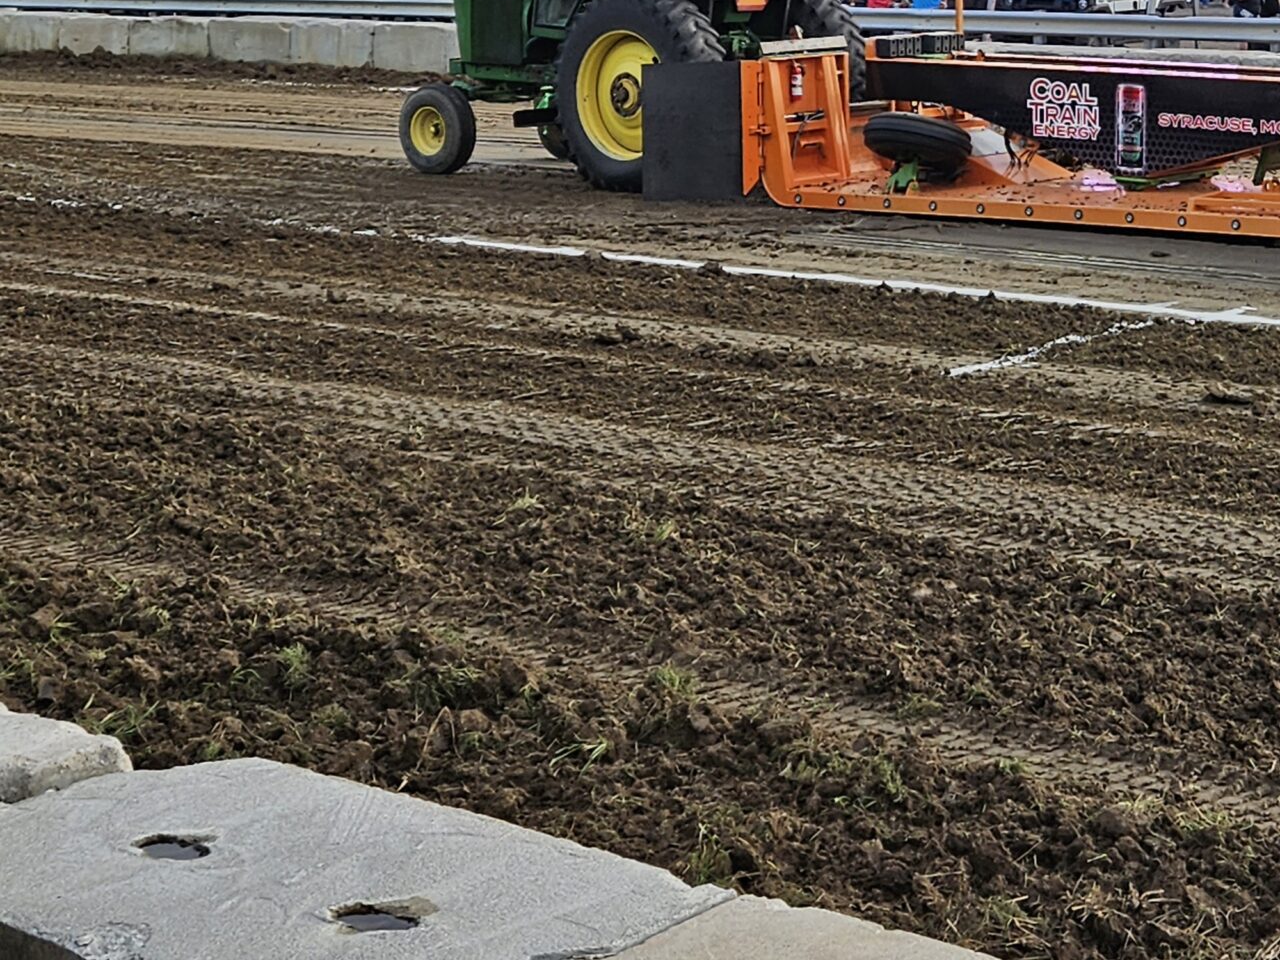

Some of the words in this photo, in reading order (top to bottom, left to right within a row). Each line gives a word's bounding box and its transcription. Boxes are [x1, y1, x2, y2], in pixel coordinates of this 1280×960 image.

[1029, 77, 1099, 106] COAL
[1027, 98, 1100, 127] TRAIN
[1157, 112, 1258, 136] SYRACUSE,
[1032, 123, 1101, 140] ENERGY
